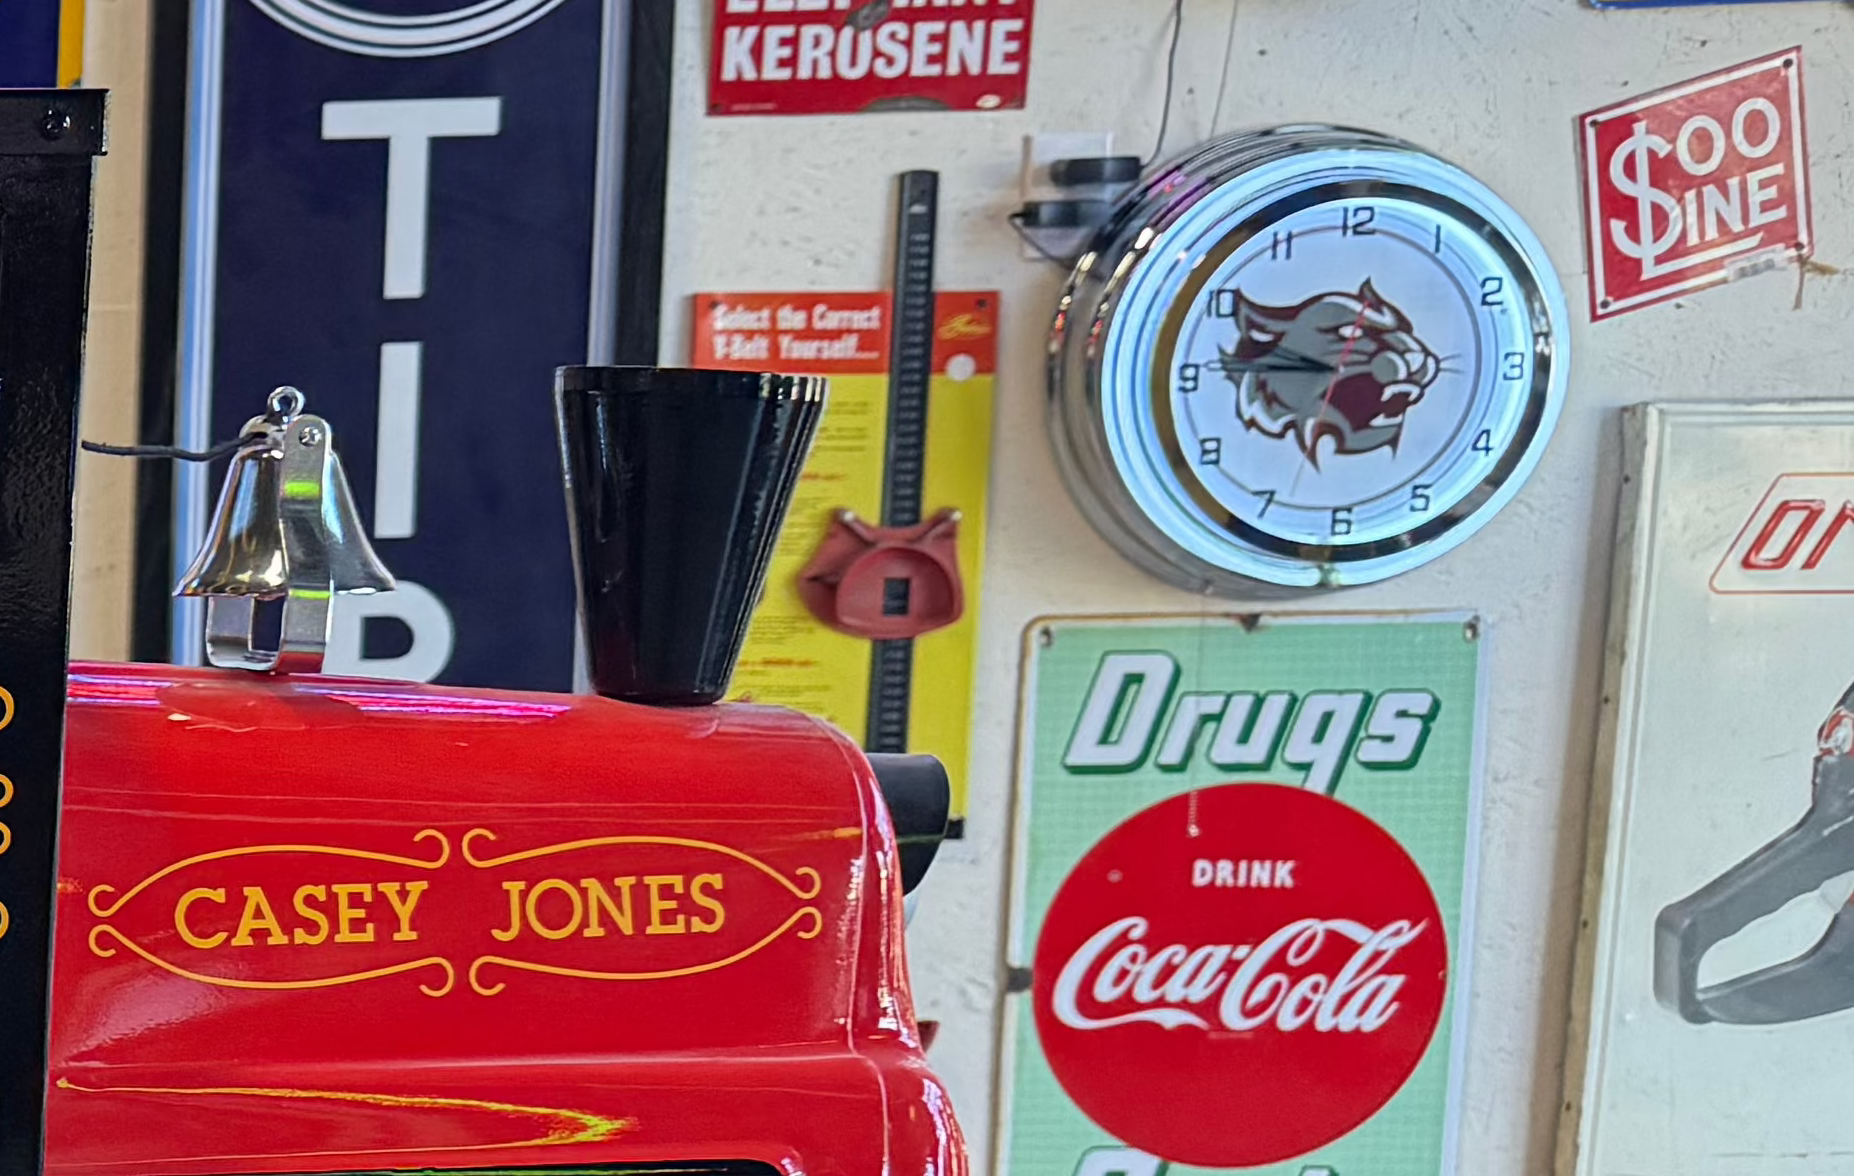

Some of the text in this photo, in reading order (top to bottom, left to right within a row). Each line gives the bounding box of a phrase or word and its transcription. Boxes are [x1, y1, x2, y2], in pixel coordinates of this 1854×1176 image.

[721, 19, 1024, 81] KEROSENE
[1342, 206, 1375, 237] 12
[1271, 231, 1293, 260] 11
[1434, 224, 1442, 254] 1
[1206, 288, 1237, 318] 10
[1480, 276, 1503, 306] 2
[1179, 363, 1200, 392] 9
[1503, 352, 1525, 381] 3
[1200, 437, 1221, 465] 8
[1471, 429, 1494, 456] 4
[1251, 490, 1276, 519] 7
[1409, 484, 1433, 512] 5
[1330, 508, 1354, 536] 6
[1063, 650, 1442, 800] Drugs
[1192, 859, 1296, 888] DRINK
[174, 874, 726, 949] CASEY JONES
[1052, 916, 1430, 1033] Coca-Cola
